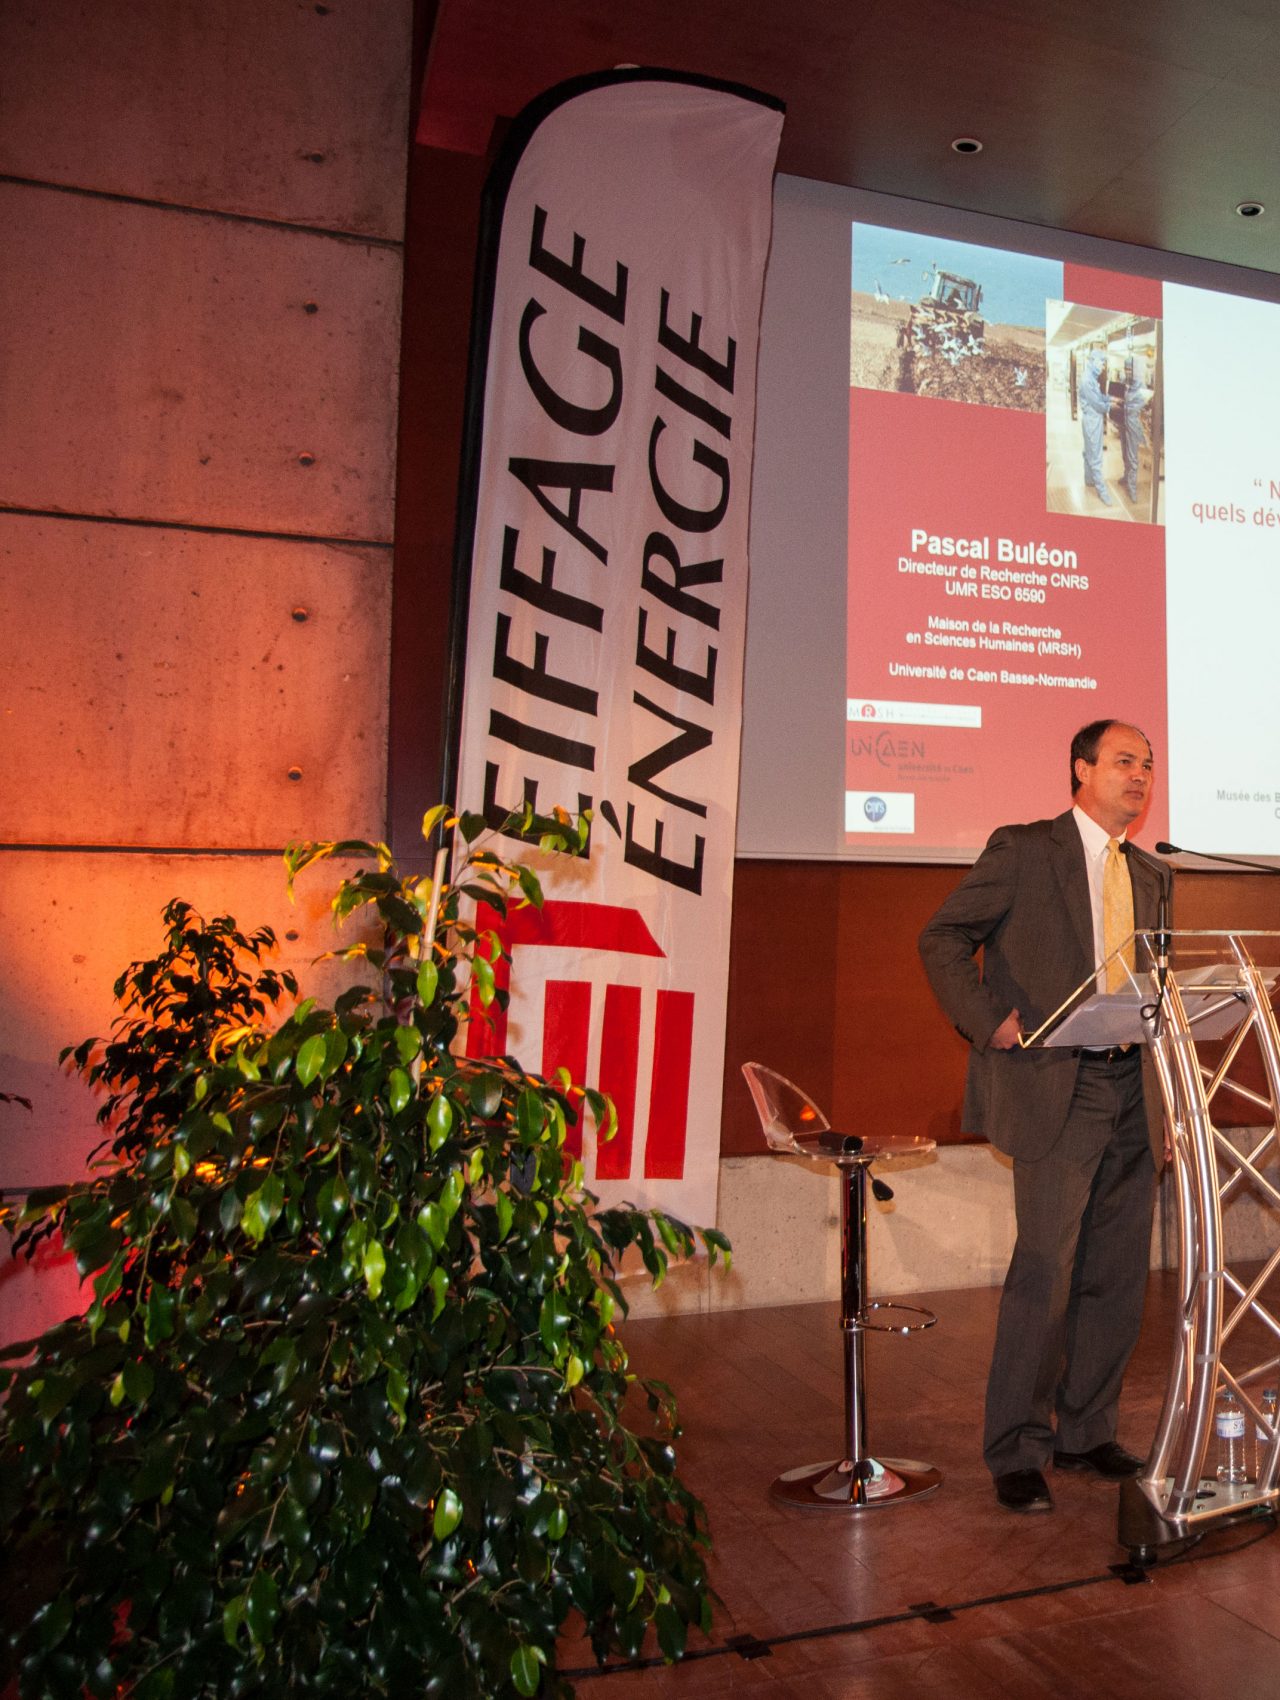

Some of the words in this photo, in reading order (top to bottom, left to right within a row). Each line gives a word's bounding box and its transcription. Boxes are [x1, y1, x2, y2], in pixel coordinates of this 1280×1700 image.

[1192, 501, 1246, 524] quels
[482, 204, 629, 860] EIFFAGE
[911, 528, 989, 559] Pascal
[997, 538, 1077, 569] Buléon
[898, 557, 957, 577] Directeur
[960, 564, 977, 579] de
[980, 565, 1048, 586] Recherche
[1050, 573, 1089, 590] CNRS
[600, 287, 737, 896] ÉNERGIE
[945, 581, 978, 598] UMR
[981, 584, 1011, 600] ESO
[1014, 588, 1046, 604] 6590
[928, 615, 969, 632] Maison
[972, 619, 987, 633] de
[989, 621, 1000, 634] la
[1002, 622, 1061, 639] Recherche
[906, 632, 921, 644] en
[924, 632, 976, 649] Sciences
[979, 636, 1035, 653] Humaines
[1037, 641, 1081, 659] (MRSH)
[889, 662, 947, 680] Université
[949, 667, 964, 681] de
[967, 668, 997, 683] Caen
[1000, 670, 1097, 690] Basse-Normandie
[1216, 789, 1250, 801] Musée
[1252, 791, 1272, 803] des
